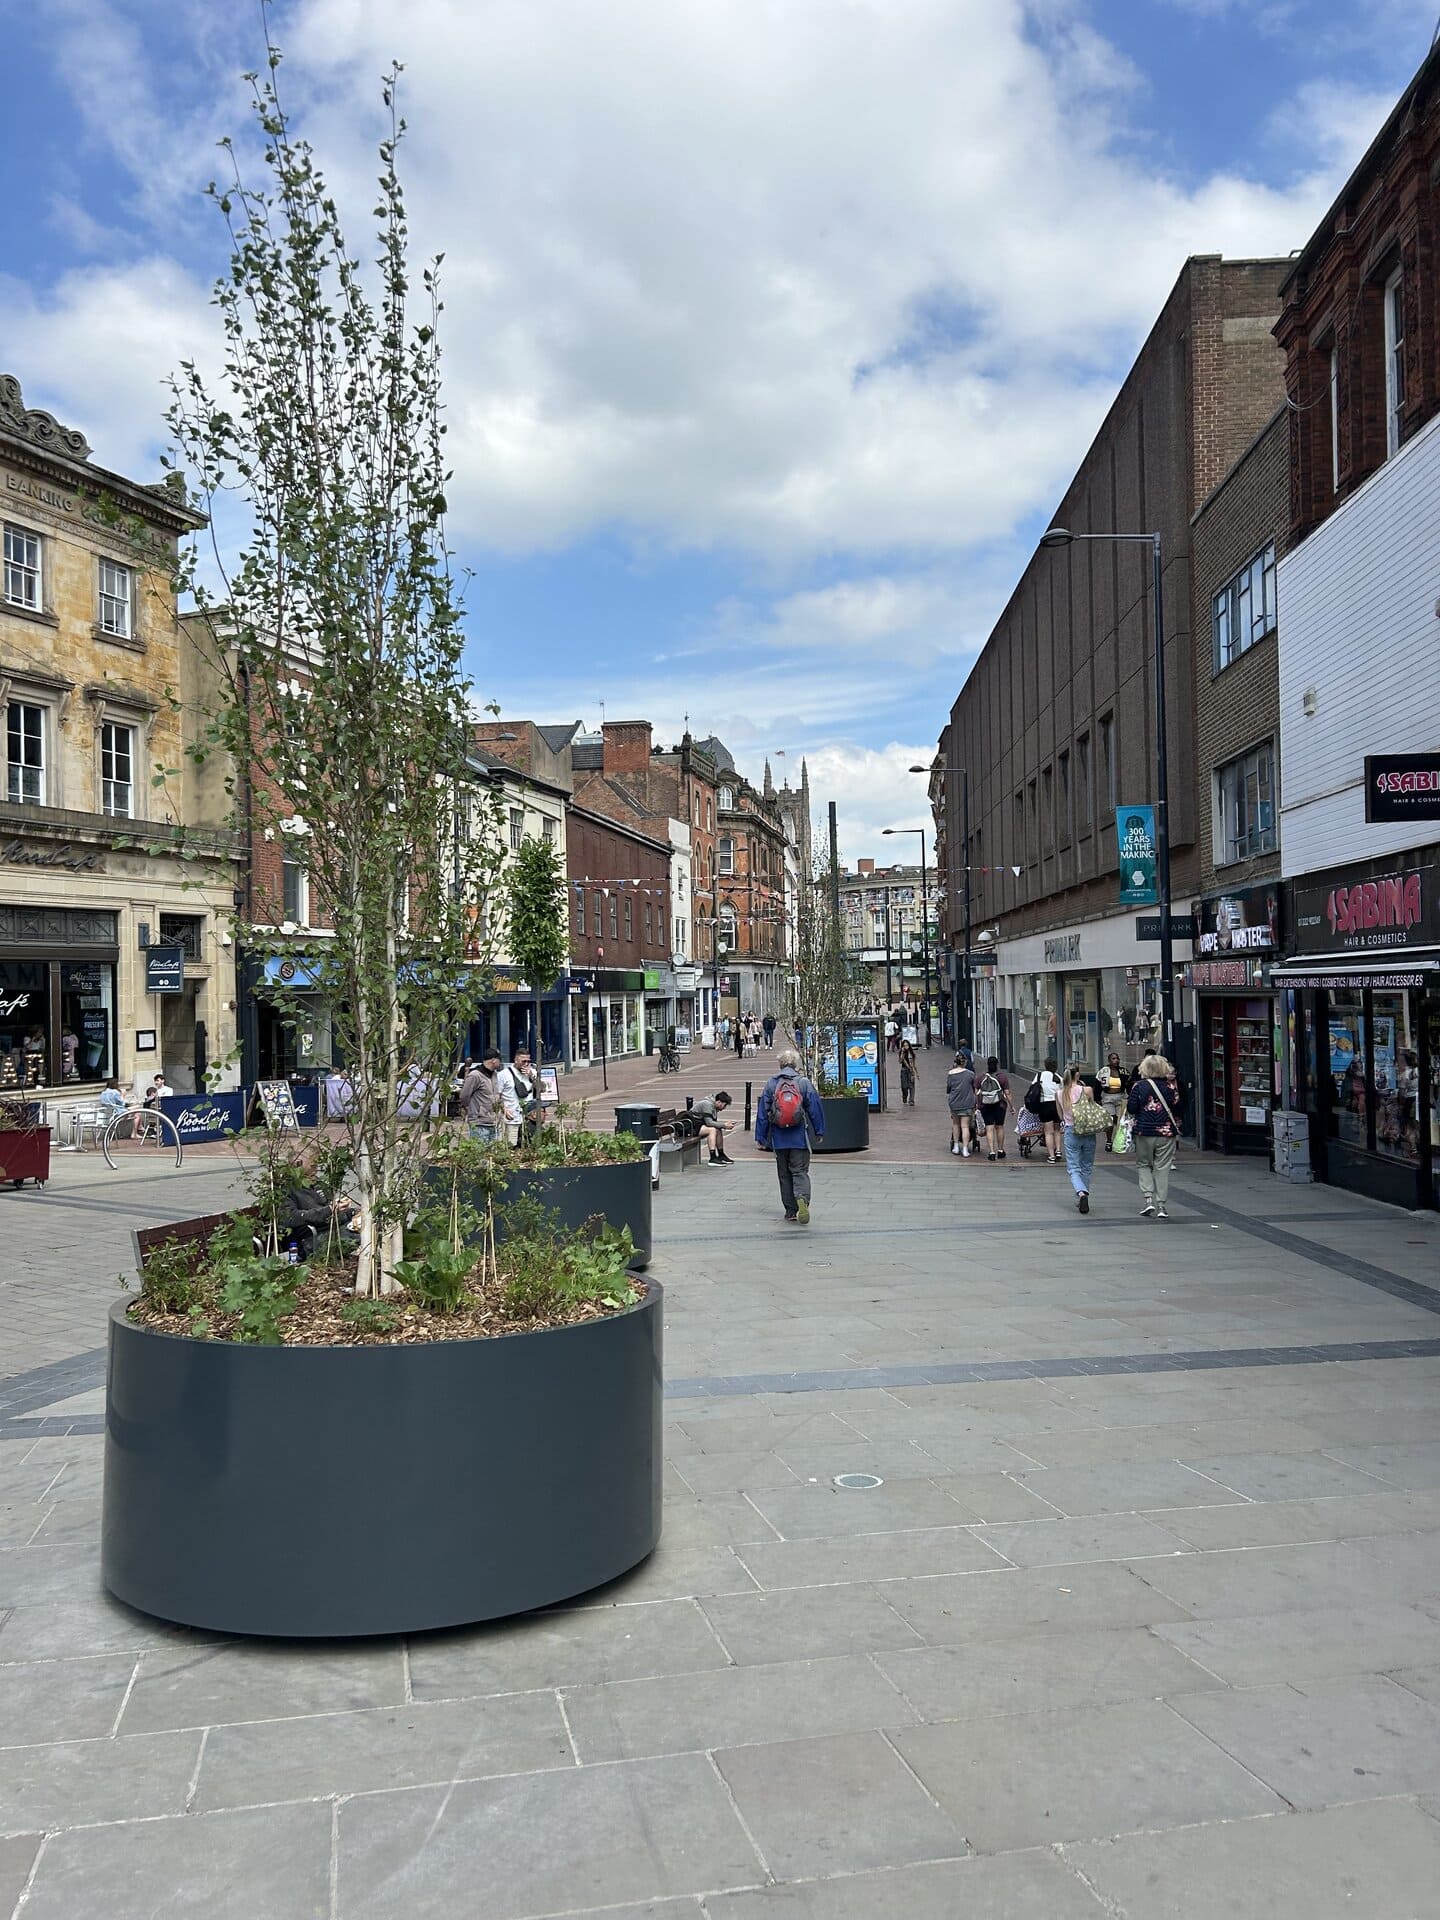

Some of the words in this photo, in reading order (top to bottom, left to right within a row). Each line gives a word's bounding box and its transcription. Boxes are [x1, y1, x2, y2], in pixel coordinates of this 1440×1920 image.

[6, 473, 74, 511] BANKING
[1388, 771, 1440, 793] SABI
[1129, 827, 1144, 836] 300
[1123, 835, 1150, 844] YEARS
[1123, 843, 1132, 851] IN
[1133, 842, 1152, 851] THE
[1337, 873, 1421, 935] SABINA
[929, 926, 936, 937] P
[1143, 922, 1192, 933] PRIARK
[1200, 933, 1218, 952] VAPE
[1344, 936, 1358, 947] HAIR
[1361, 936, 1365, 945] &
[1367, 932, 1407, 945] COSMETICS
[1044, 933, 1081, 965] PRIMARK
